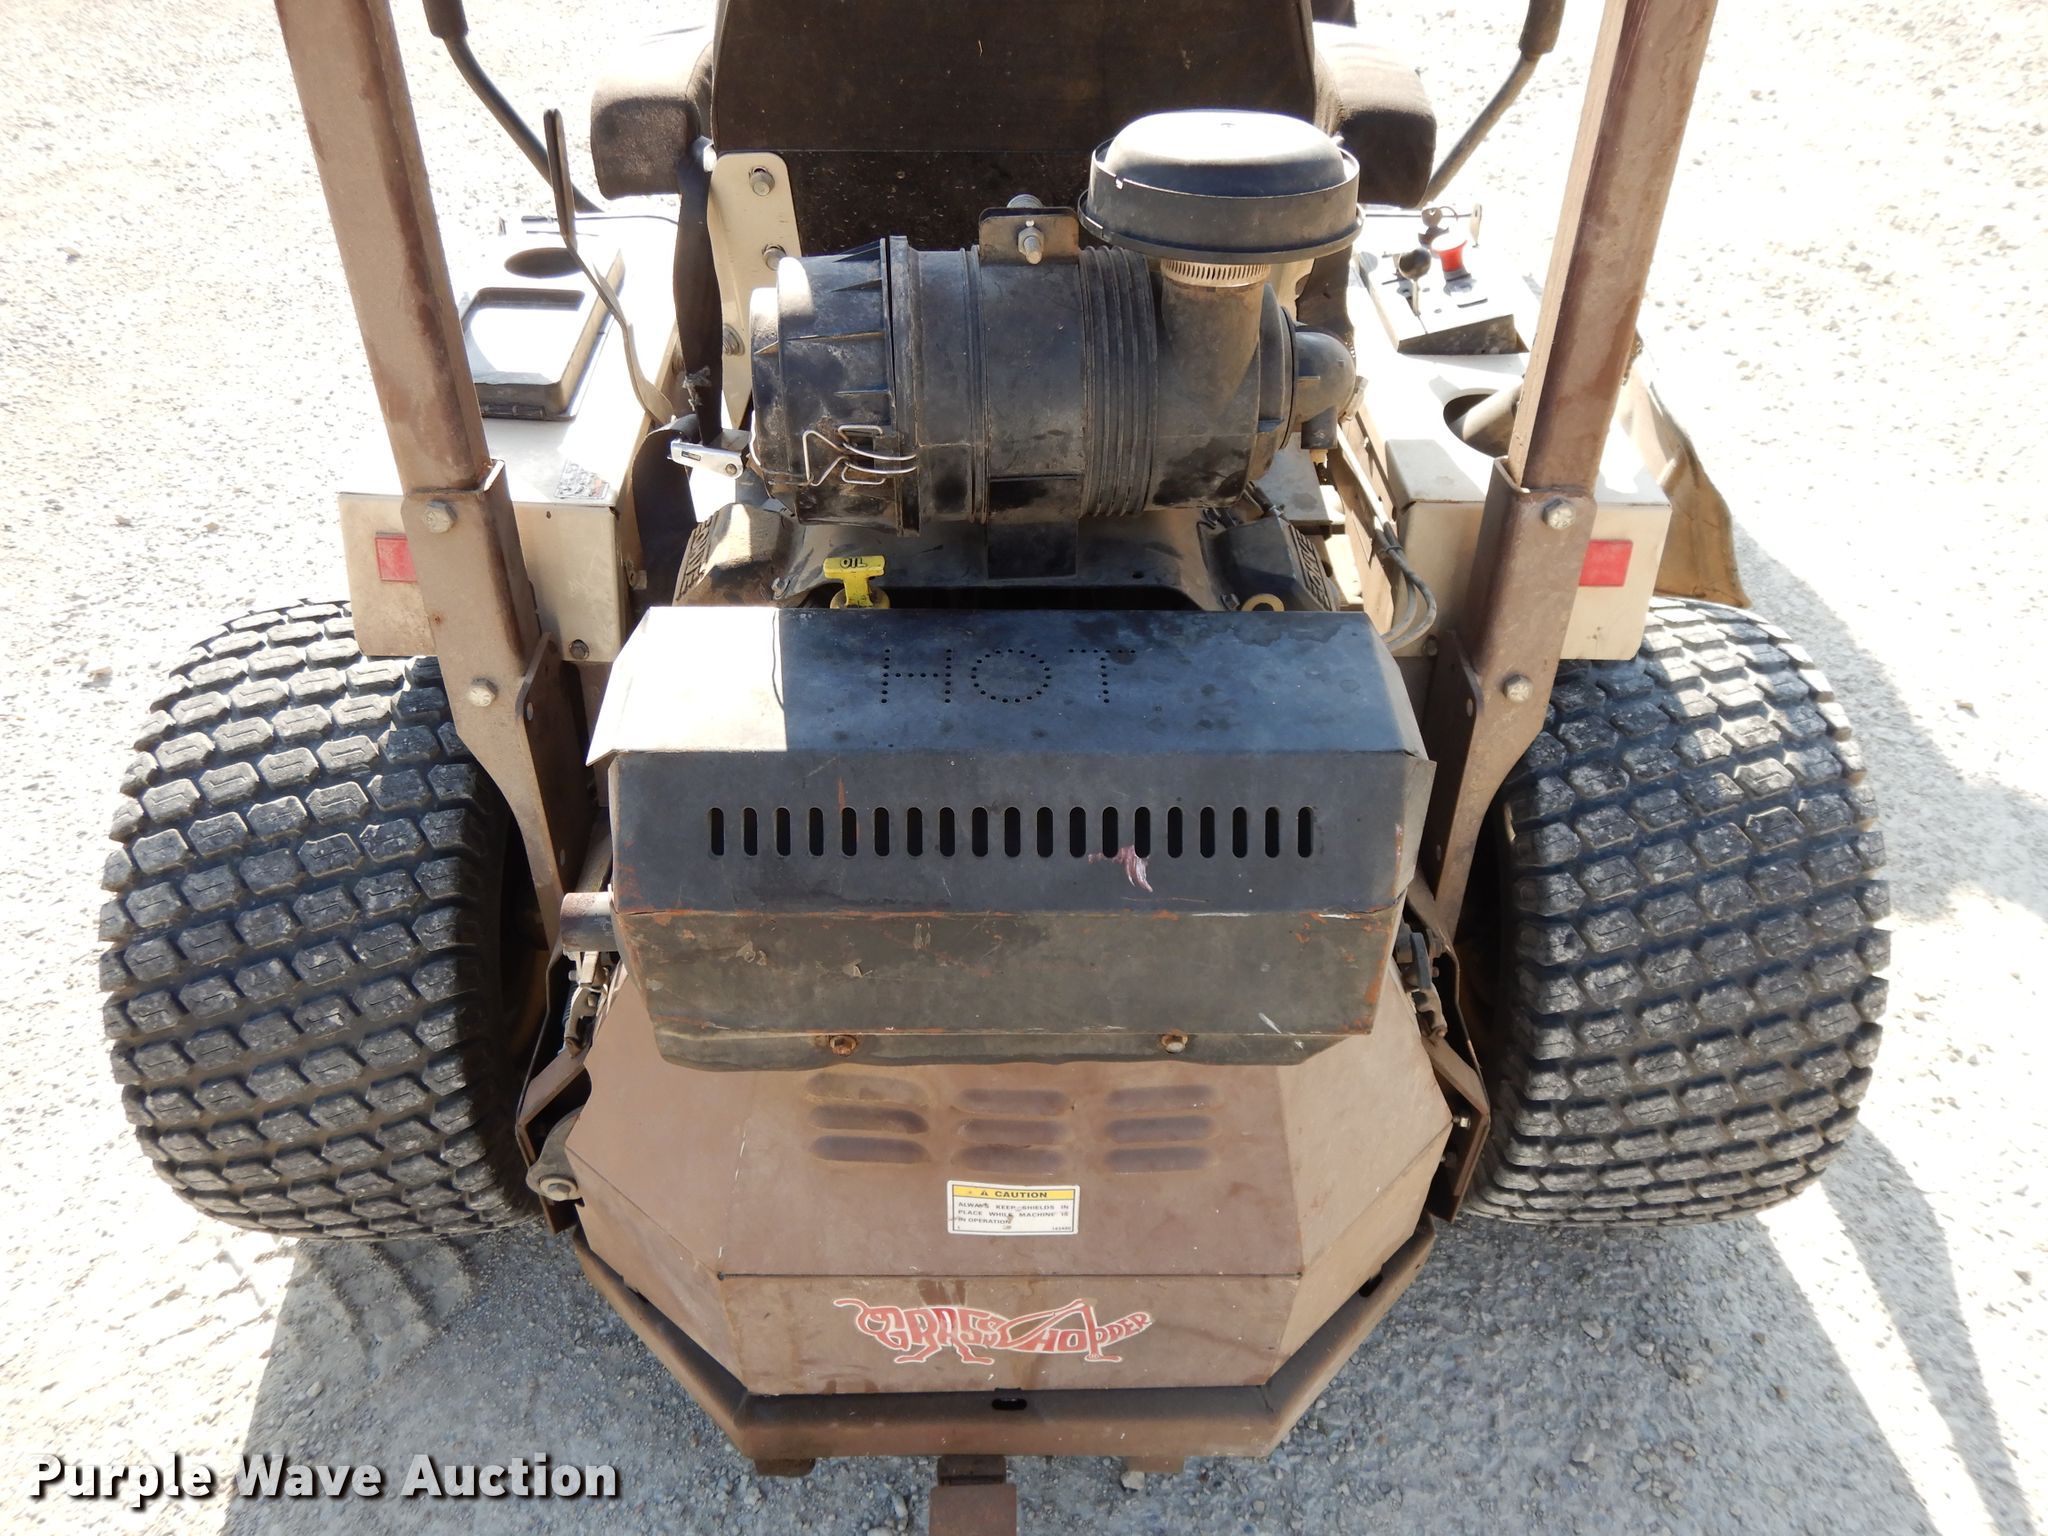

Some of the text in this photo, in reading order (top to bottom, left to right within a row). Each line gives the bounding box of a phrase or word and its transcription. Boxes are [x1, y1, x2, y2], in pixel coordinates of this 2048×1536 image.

[840, 557, 867, 568] OIL
[880, 648, 1136, 704] HOT
[994, 1190, 1048, 1198] CAUTION
[958, 1201, 989, 1209] ALWAYS
